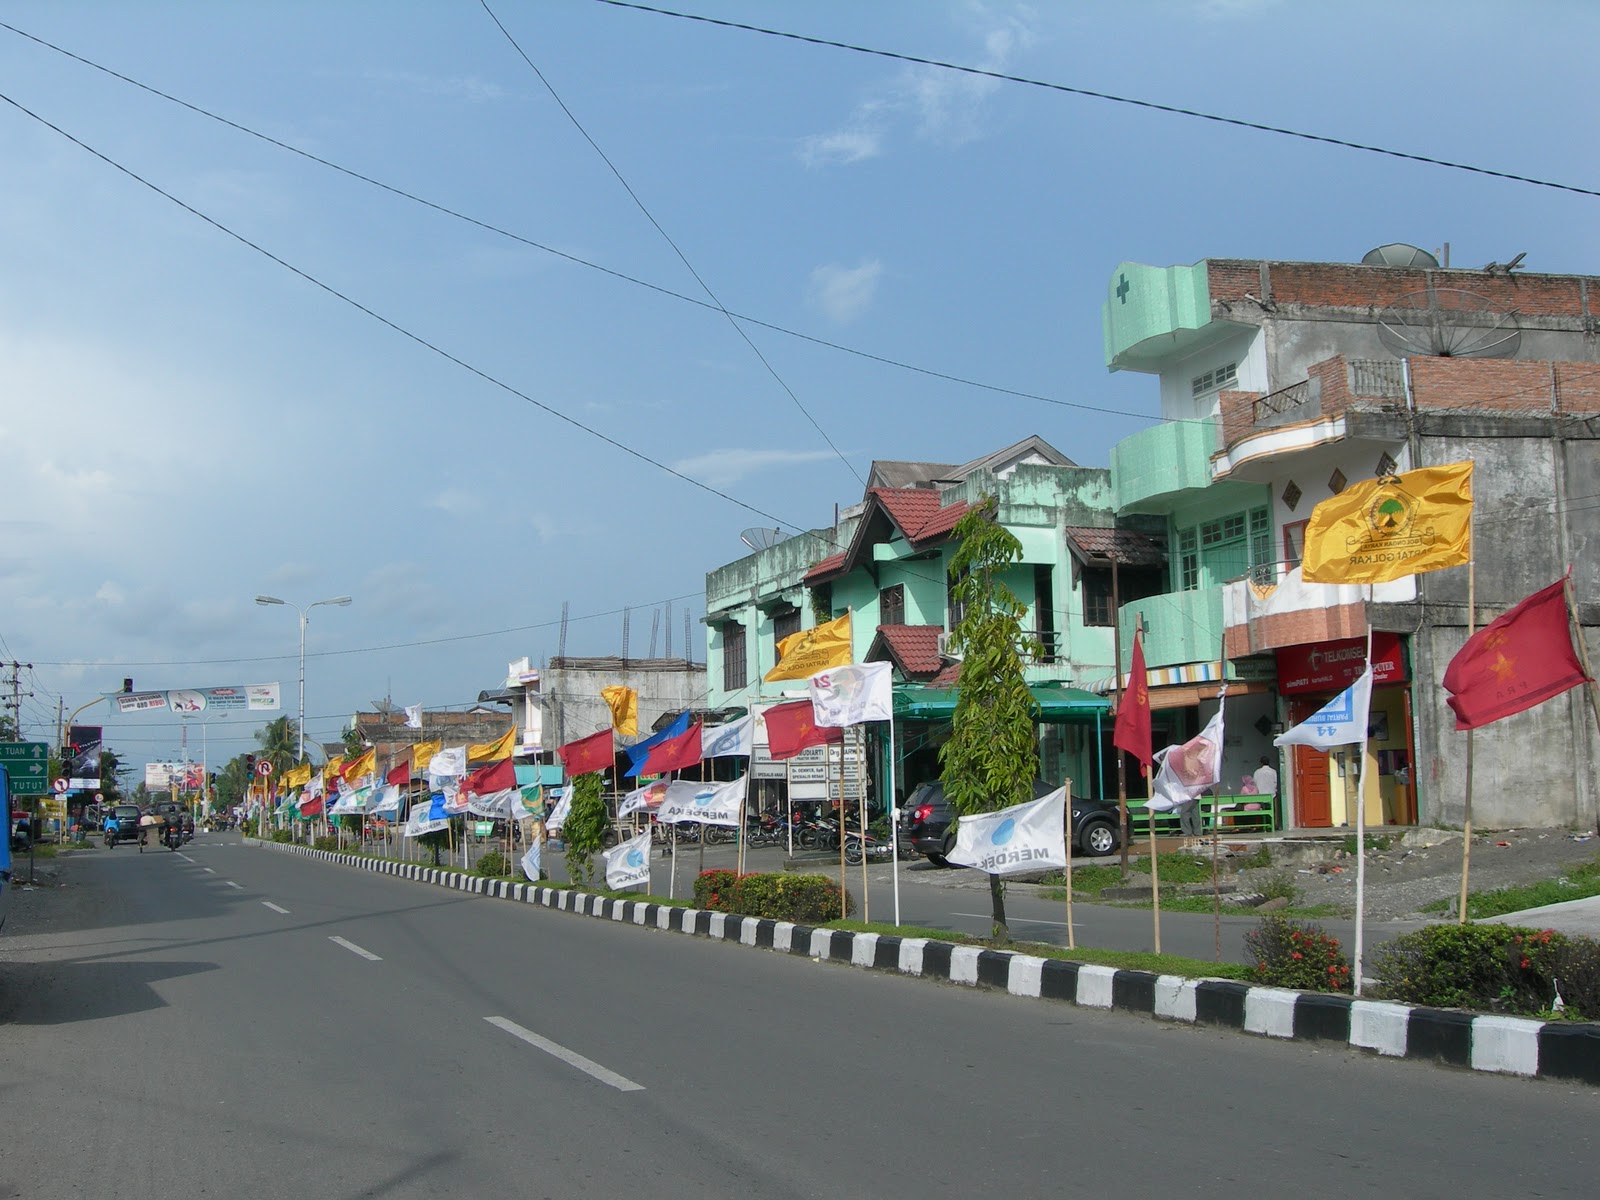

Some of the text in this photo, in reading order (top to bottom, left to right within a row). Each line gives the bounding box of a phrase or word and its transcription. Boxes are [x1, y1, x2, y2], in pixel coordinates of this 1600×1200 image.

[1323, 647, 1367, 663] TELKOMSEL
[1286, 679, 1309, 688] simPATI
[1327, 713, 1349, 721] PARTAI
[1316, 726, 1337, 737] 44
[5, 747, 25, 755] TUAN
[13, 782, 43, 790] TUTUT
